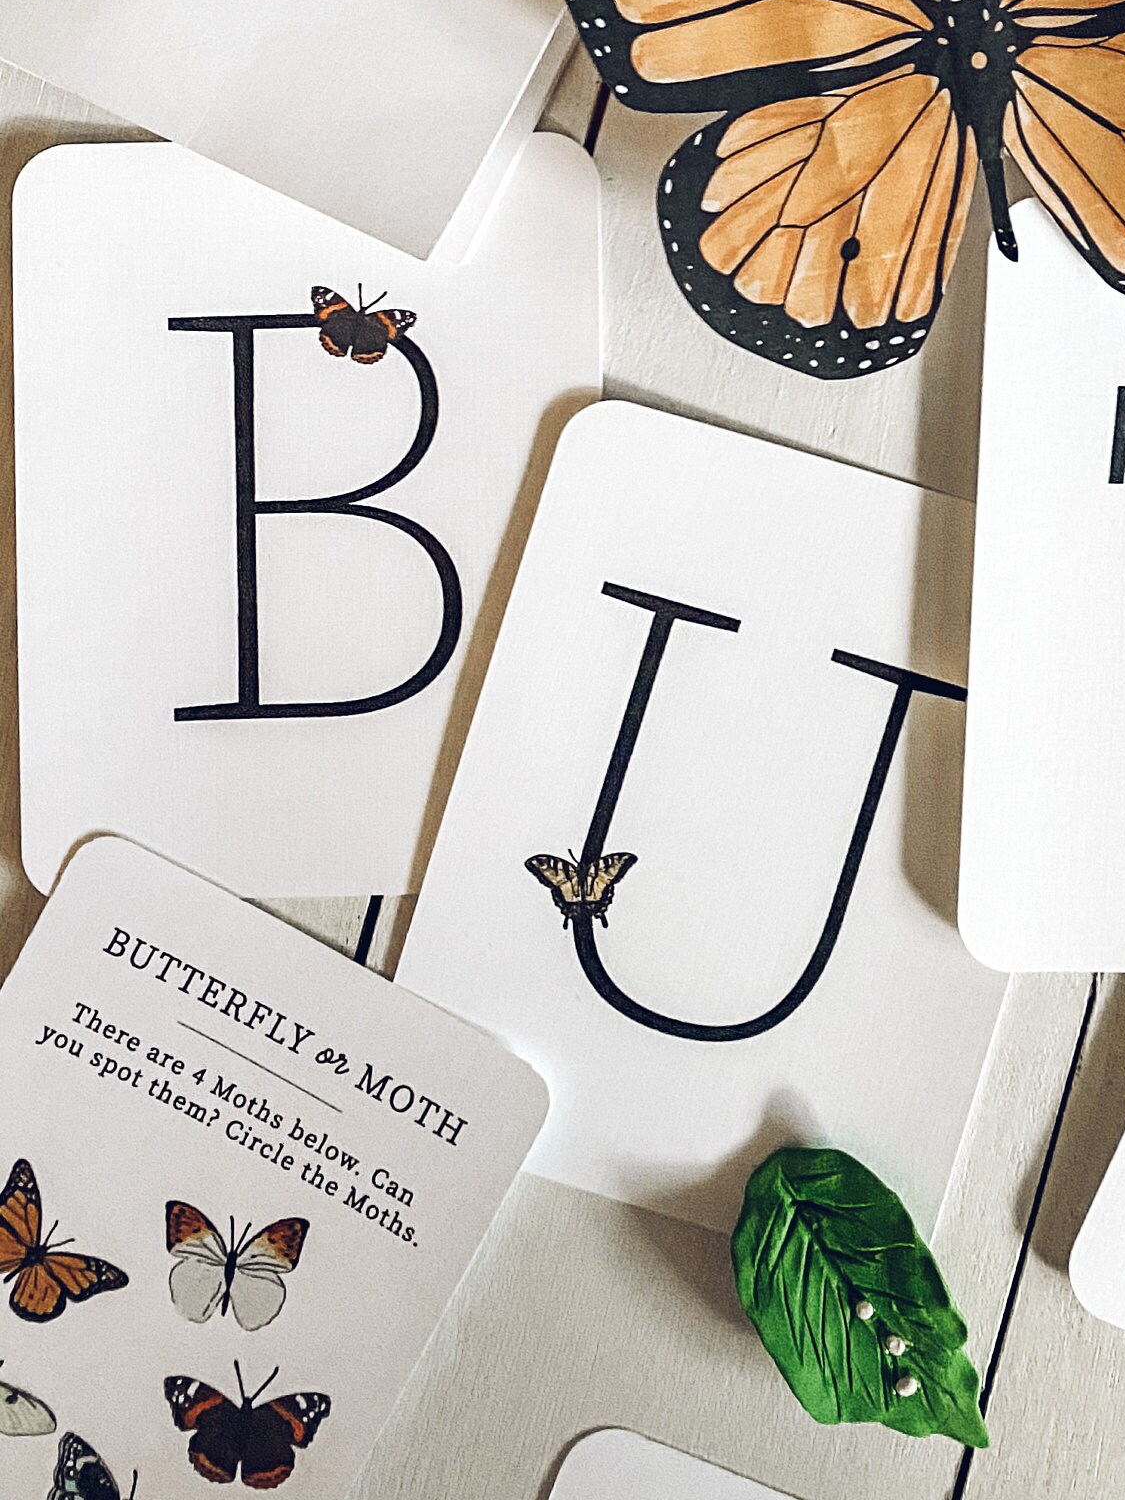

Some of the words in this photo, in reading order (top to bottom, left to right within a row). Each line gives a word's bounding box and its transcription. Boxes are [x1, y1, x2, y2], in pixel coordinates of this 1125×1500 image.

[168, 316, 463, 722] B
[573, 580, 969, 1042] U
[35, 1025, 84, 1058] you
[89, 1052, 143, 1088] spot
[148, 1078, 221, 1128] them?
[225, 1120, 295, 1171] Circle
[300, 1162, 339, 1197] the
[342, 1185, 418, 1248] Moths.
[72, 1002, 141, 1052] There
[146, 1046, 185, 1075] are
[192, 1068, 207, 1086] 4
[209, 1075, 284, 1129] Moths
[287, 1117, 361, 1176] below.
[371, 1168, 414, 1208] Can
[102, 927, 316, 1055] BUTTERFLY
[314, 1047, 350, 1075] or
[354, 1063, 469, 1147] MOTH
